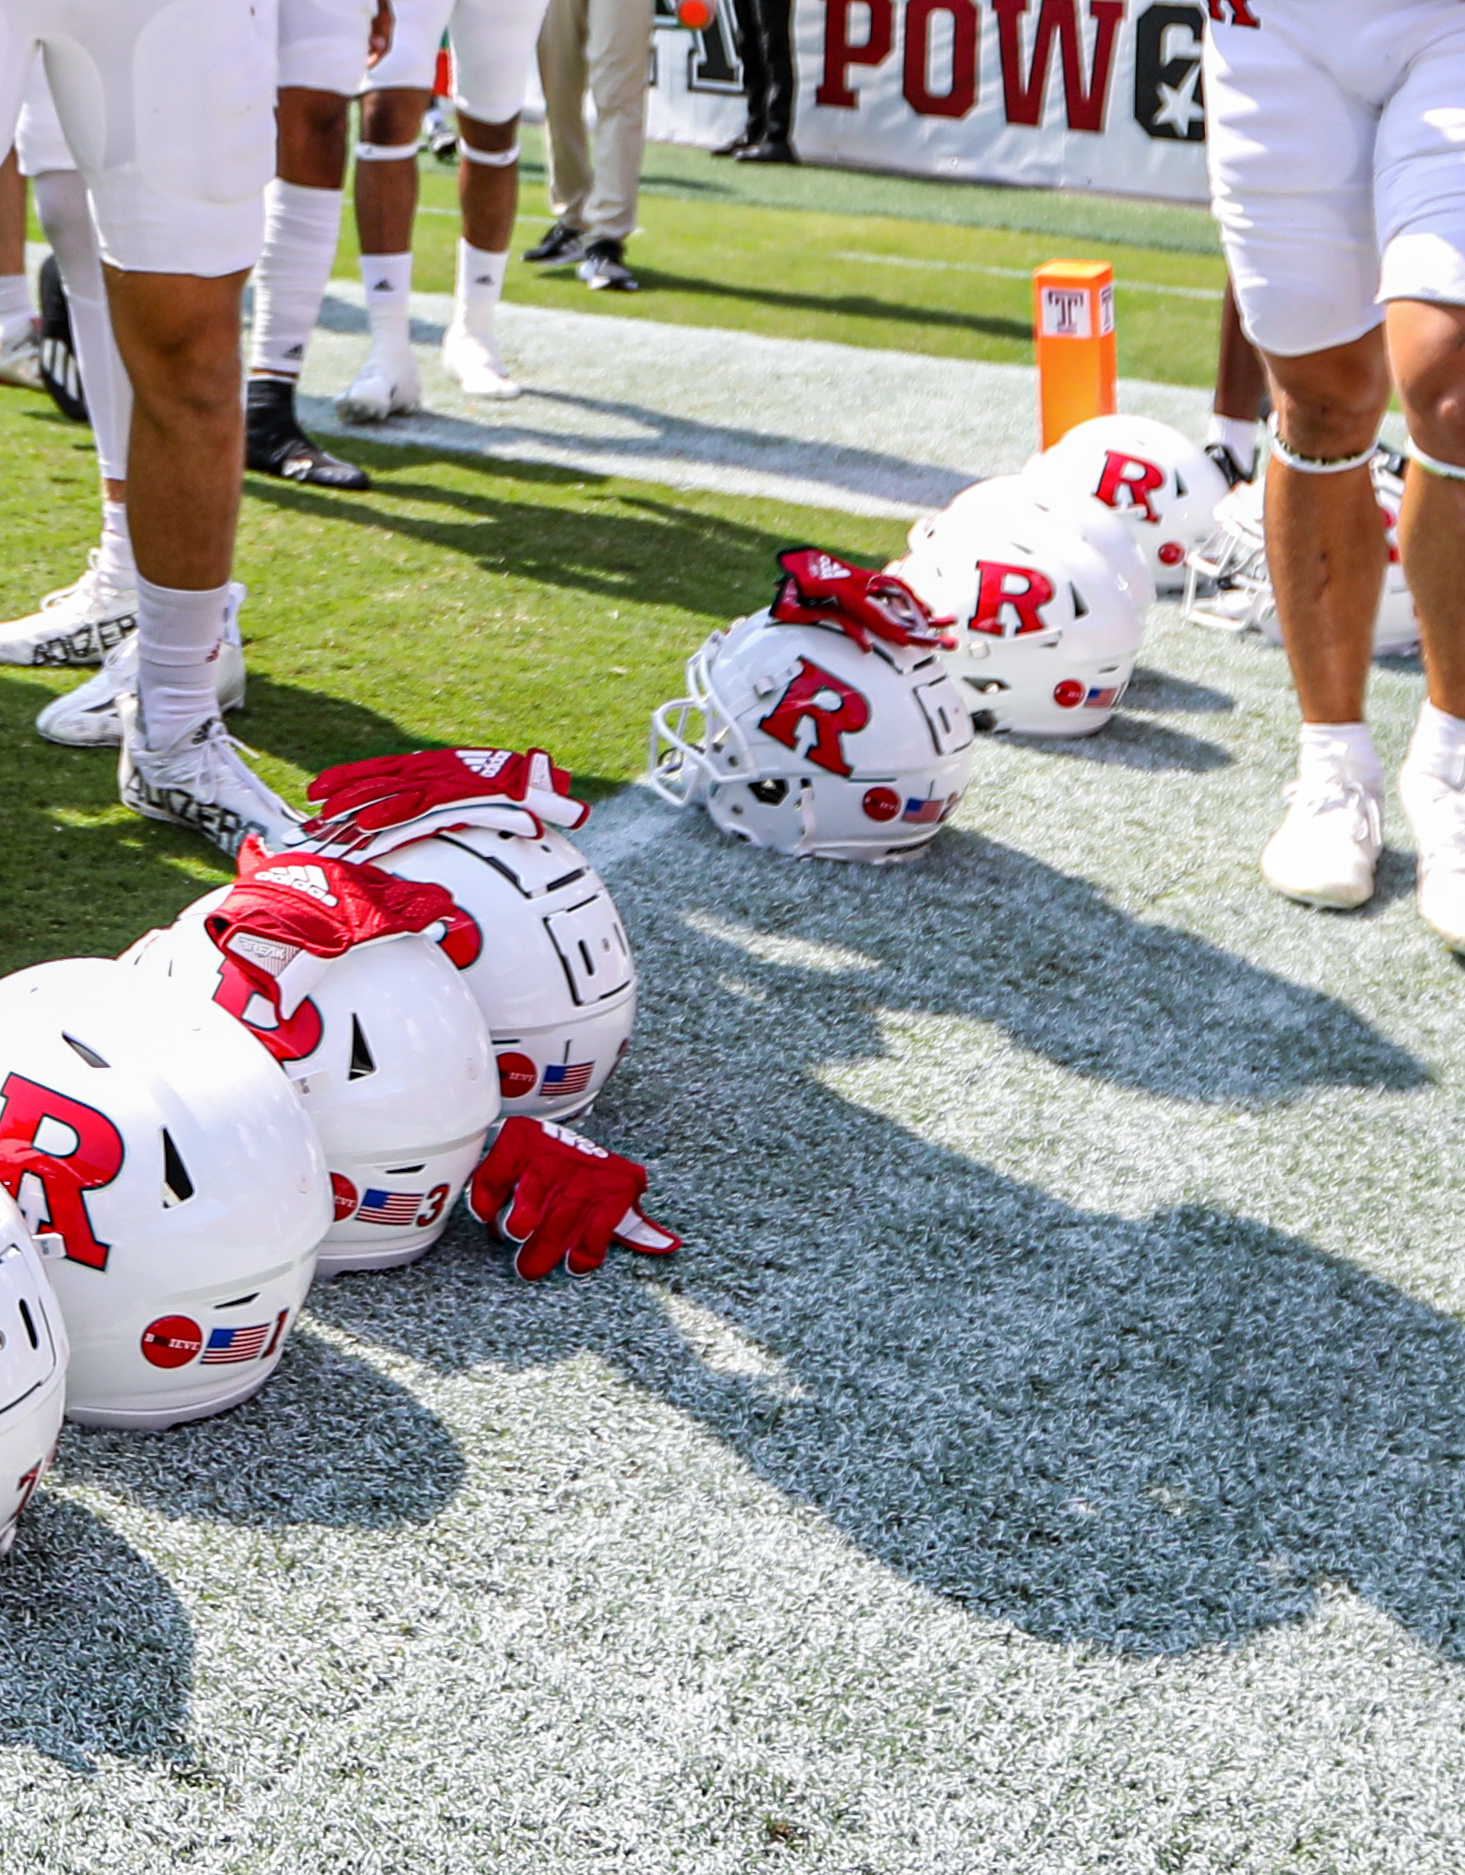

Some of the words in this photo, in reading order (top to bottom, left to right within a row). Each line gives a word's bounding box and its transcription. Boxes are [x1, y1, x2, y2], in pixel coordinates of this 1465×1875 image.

[1048, 289, 1085, 335] T
[1094, 449, 1167, 524] R
[968, 560, 1055, 637] R
[759, 655, 872, 779] R
[254, 869, 339, 908] adidas
[416, 1183, 451, 1228] 3
